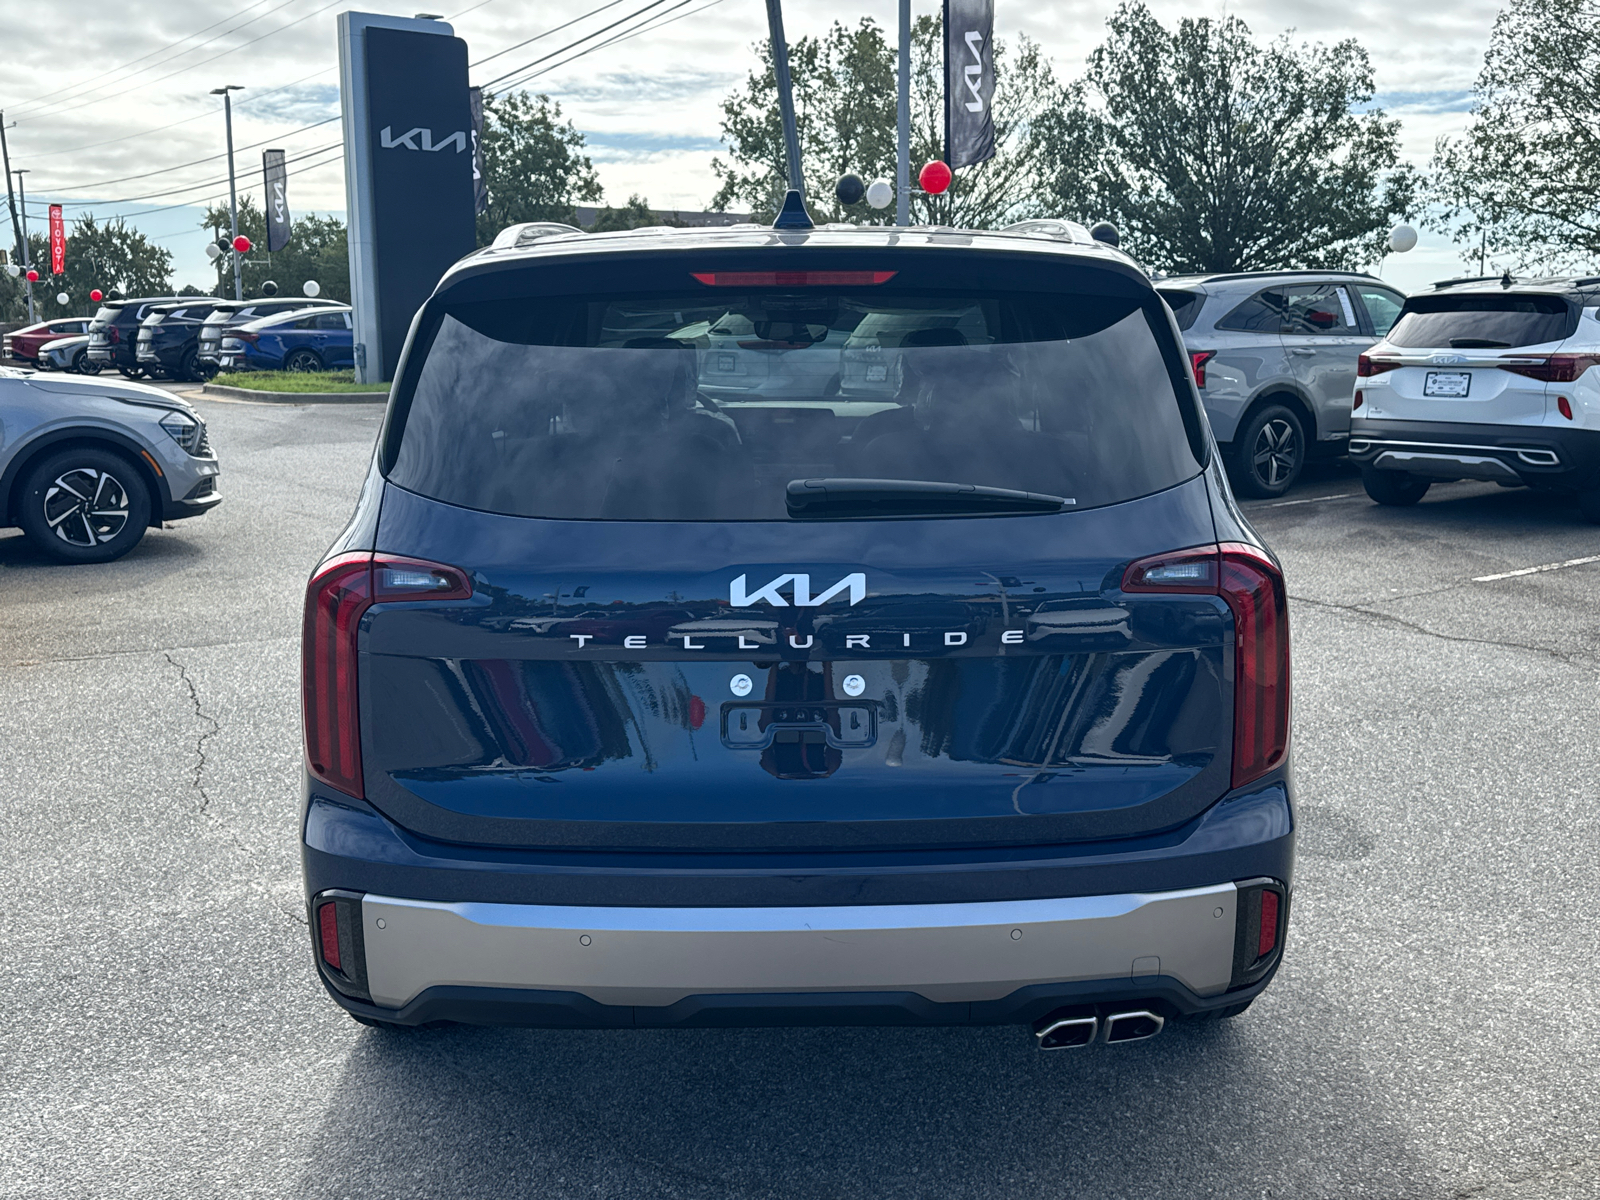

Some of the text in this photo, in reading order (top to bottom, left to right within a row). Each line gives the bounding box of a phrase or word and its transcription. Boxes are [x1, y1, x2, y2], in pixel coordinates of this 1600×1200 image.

[965, 31, 983, 112] KIA
[380, 125, 467, 154] KIA
[273, 182, 284, 224] KIA
[54, 221, 62, 271] TOYOTA
[730, 573, 866, 607] KIA
[570, 629, 1025, 649] TELLURIDE
